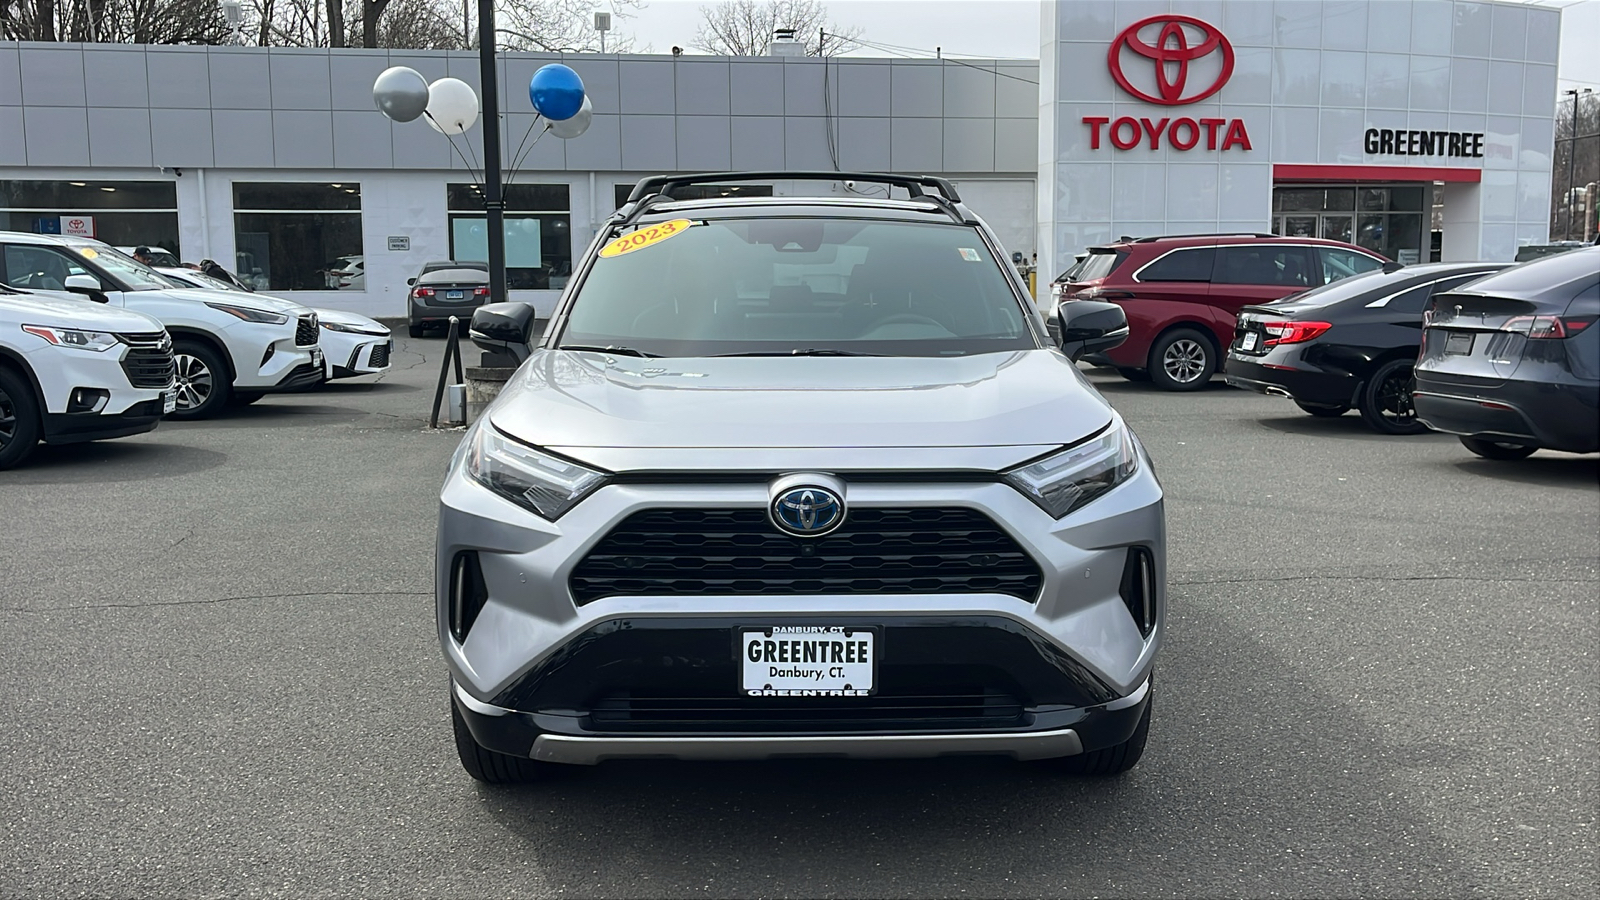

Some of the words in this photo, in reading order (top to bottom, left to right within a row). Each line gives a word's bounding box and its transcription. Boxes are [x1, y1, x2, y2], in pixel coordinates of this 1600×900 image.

[1082, 116, 1252, 151] TOYOTA
[1364, 128, 1484, 158] GREENTREE
[617, 223, 676, 252] 2023
[772, 626, 827, 634] DANBURY,
[747, 640, 868, 663] GREENTREE
[769, 666, 825, 681] Danbury,
[829, 667, 845, 678] CT.
